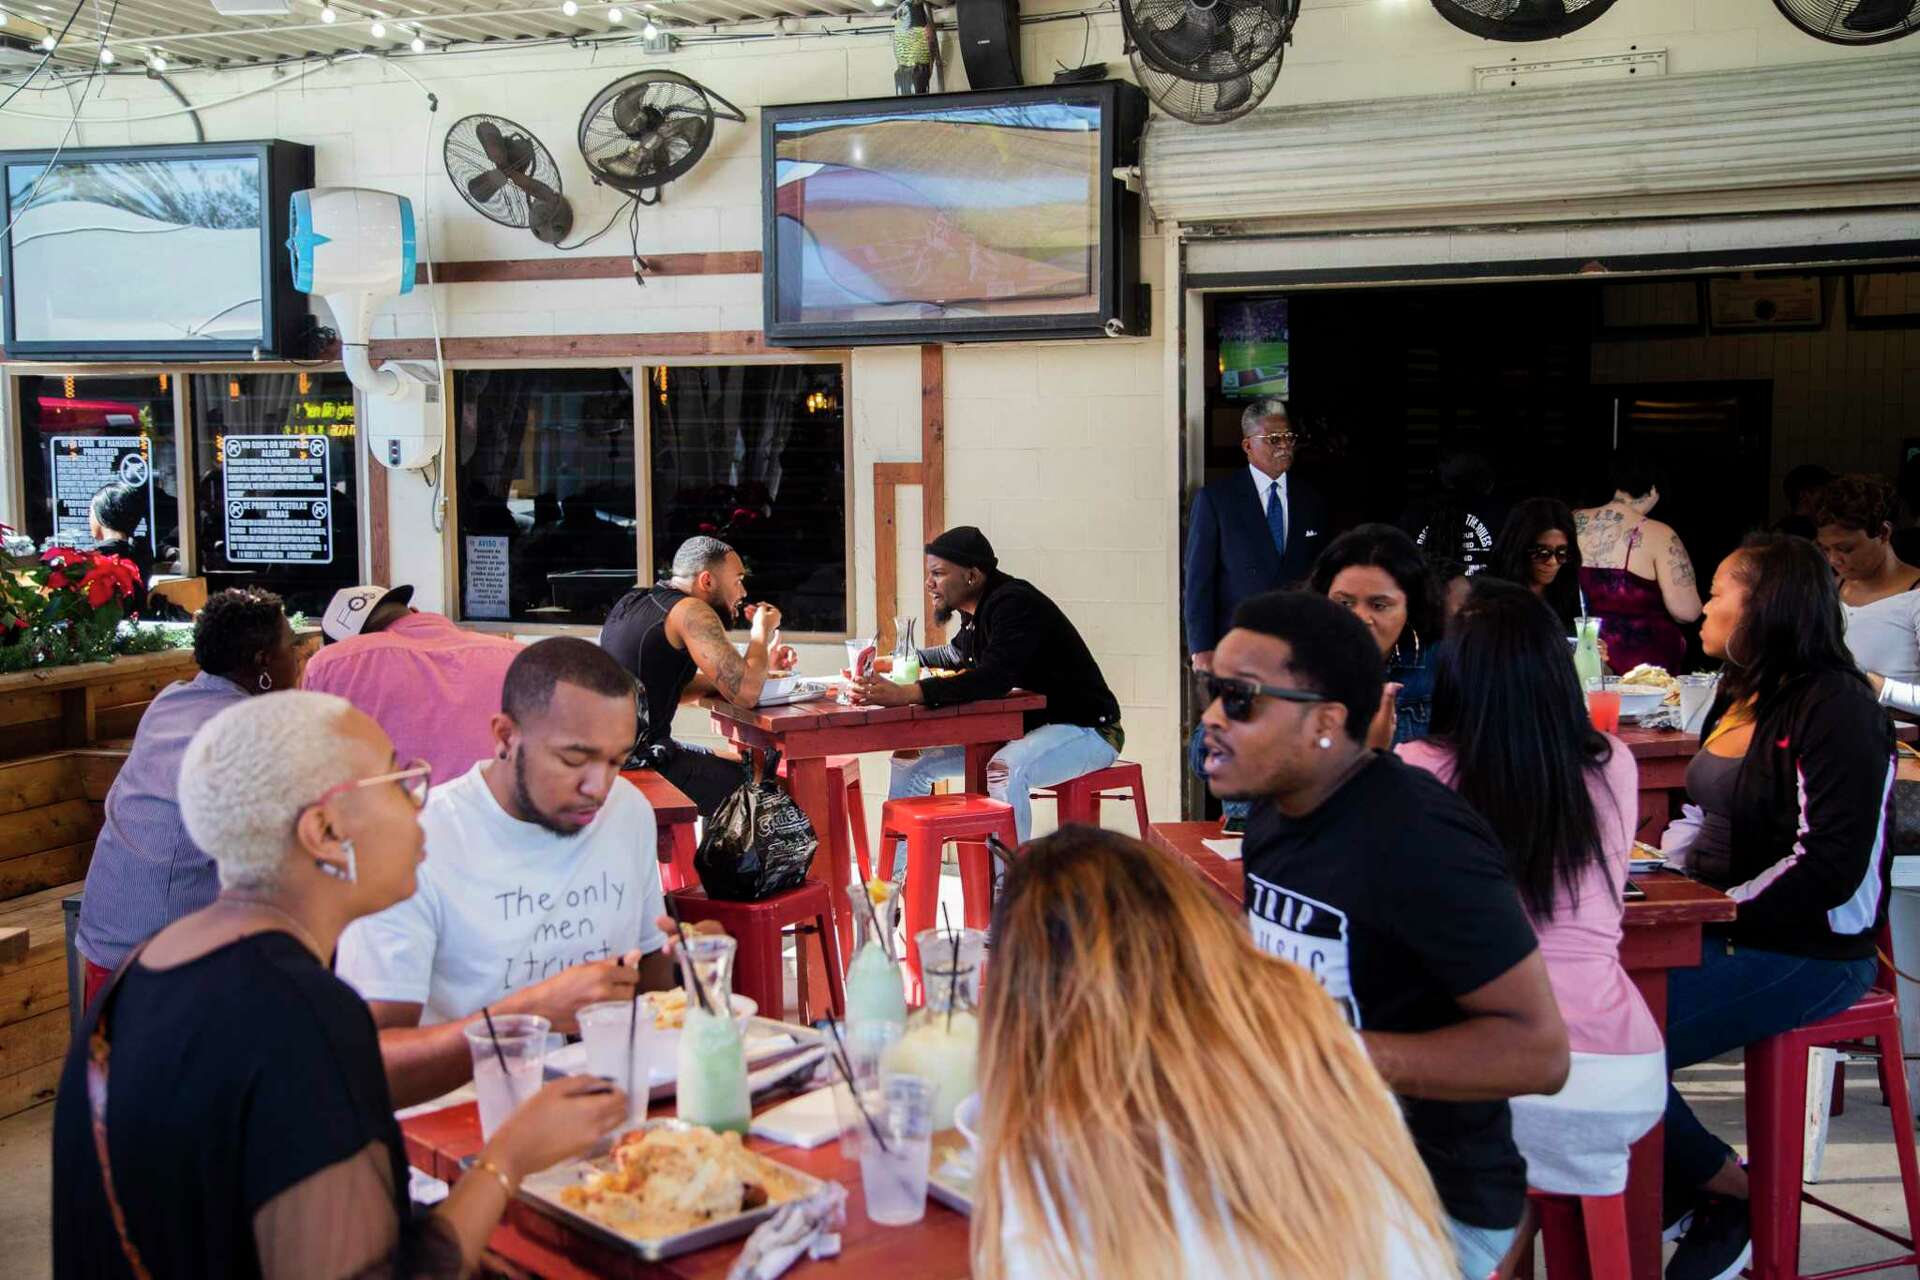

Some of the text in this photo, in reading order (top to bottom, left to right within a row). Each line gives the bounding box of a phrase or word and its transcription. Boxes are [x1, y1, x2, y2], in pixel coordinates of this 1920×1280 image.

[241, 441, 251, 449] NO
[1465, 513, 1479, 529] THE
[1475, 522, 1493, 548] RULES
[494, 871, 625, 921] The only
[1253, 883, 1313, 932] TRAP
[533, 917, 595, 943] men
[503, 957, 513, 990] I
